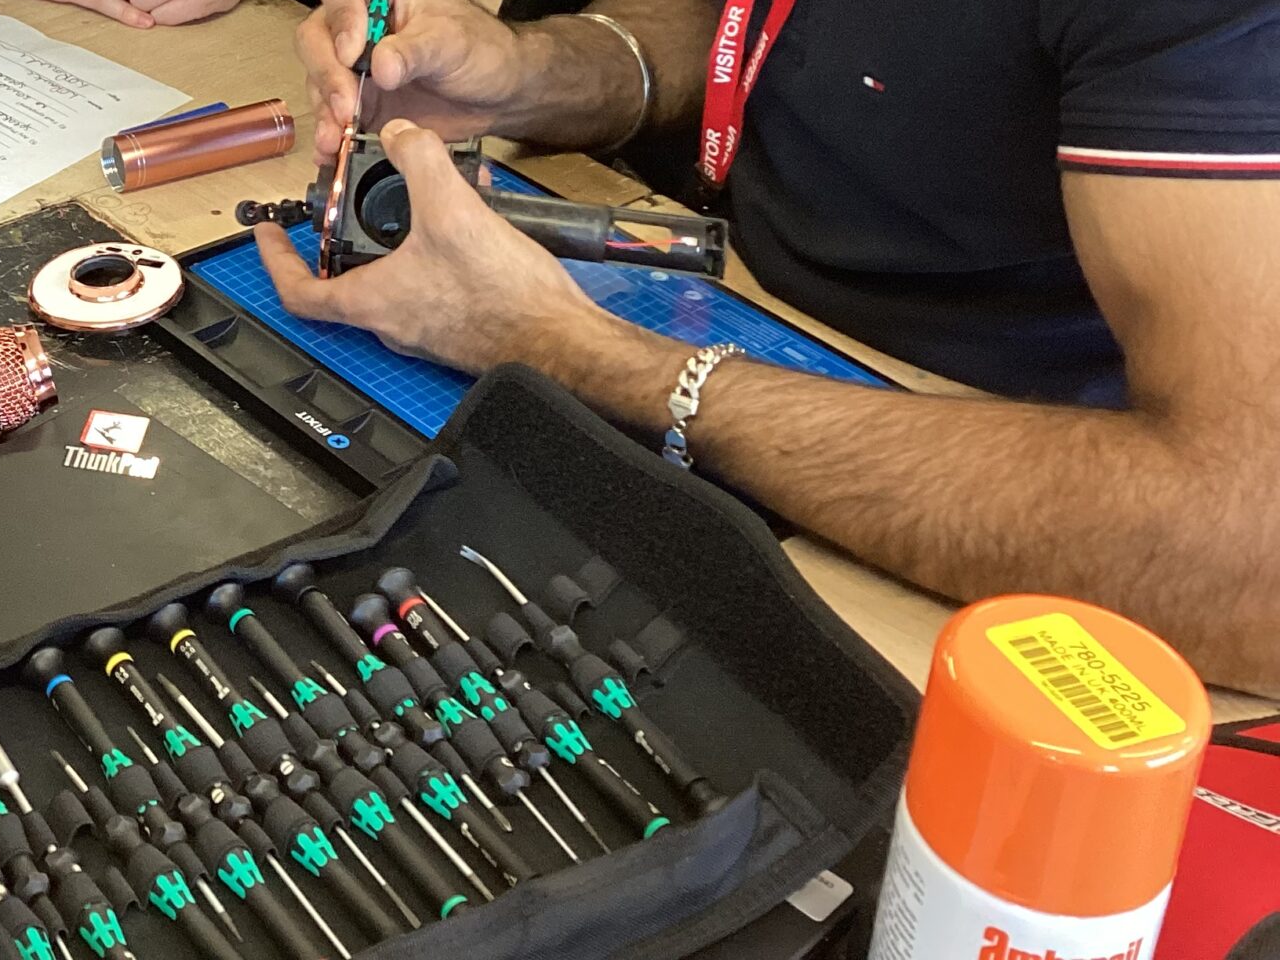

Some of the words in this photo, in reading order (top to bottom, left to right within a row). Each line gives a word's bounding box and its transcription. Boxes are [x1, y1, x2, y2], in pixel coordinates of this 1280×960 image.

[713, 6, 745, 84] VISITOR
[703, 128, 721, 181] SITOR
[64, 446, 160, 479] ThinkPad
[1039, 631, 1073, 661] MADE
[1072, 663, 1089, 676] IN
[1088, 680, 1110, 696] UK
[1109, 698, 1146, 732] 400ML
[1069, 642, 1151, 712] 780-5225
